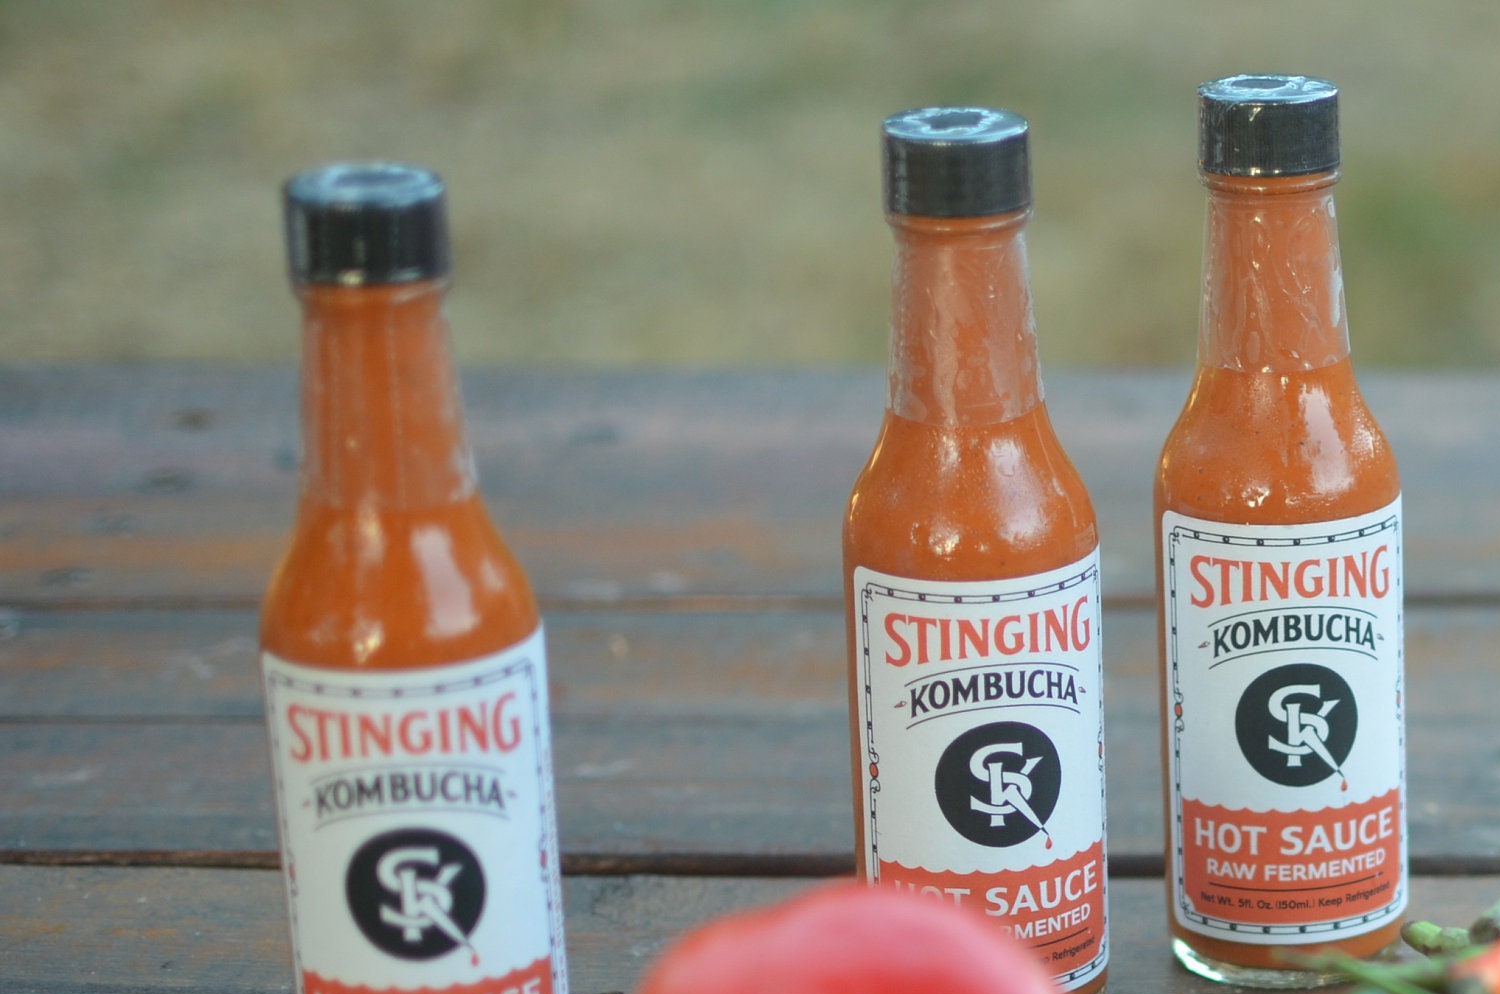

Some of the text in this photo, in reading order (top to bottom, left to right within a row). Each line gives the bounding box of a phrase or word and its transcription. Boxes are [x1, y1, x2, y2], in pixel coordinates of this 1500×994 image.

[1190, 545, 1389, 608] STINGING
[884, 595, 1090, 667] STINGING
[1213, 614, 1375, 658] KOMBUCHA
[910, 670, 1078, 717] KOMBUCHA
[287, 692, 521, 763] STINGING
[314, 770, 505, 818] KOMBUCHA
[1195, 807, 1392, 855] HOT SAUCE
[985, 860, 1097, 916] SAUCE
[1206, 848, 1386, 882] RAW FERMENTED
[1001, 903, 1091, 940] MENTED
[1318, 897, 1342, 907] Keep
